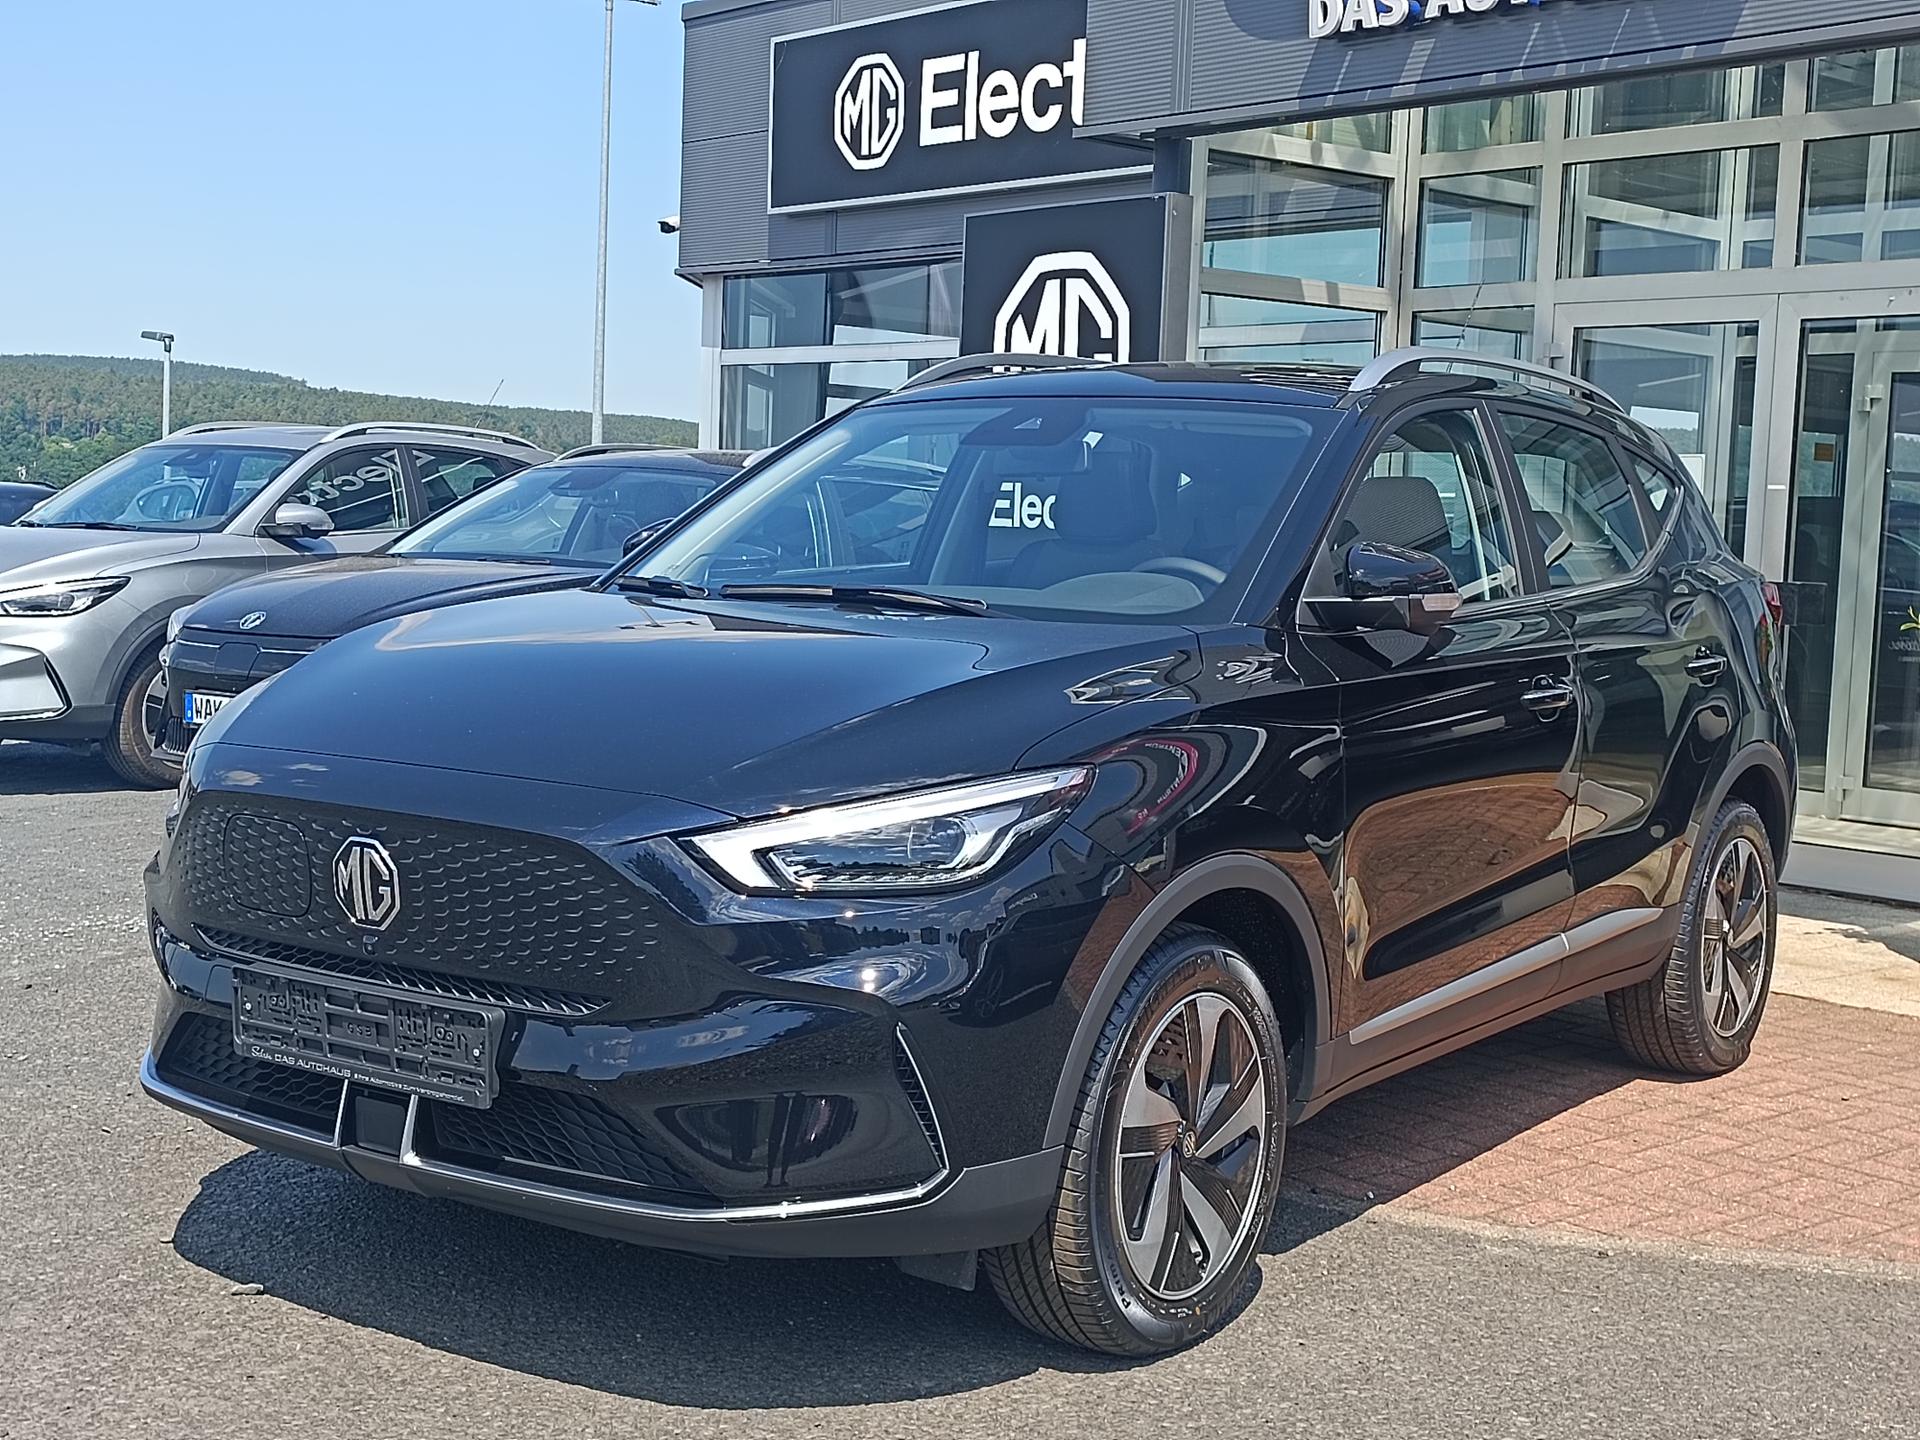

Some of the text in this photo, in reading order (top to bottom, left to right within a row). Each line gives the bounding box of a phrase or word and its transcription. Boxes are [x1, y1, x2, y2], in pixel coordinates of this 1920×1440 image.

[842, 66, 898, 157] MG
[337, 846, 392, 921] MG
[296, 1059, 351, 1077] AUTOHAUS
